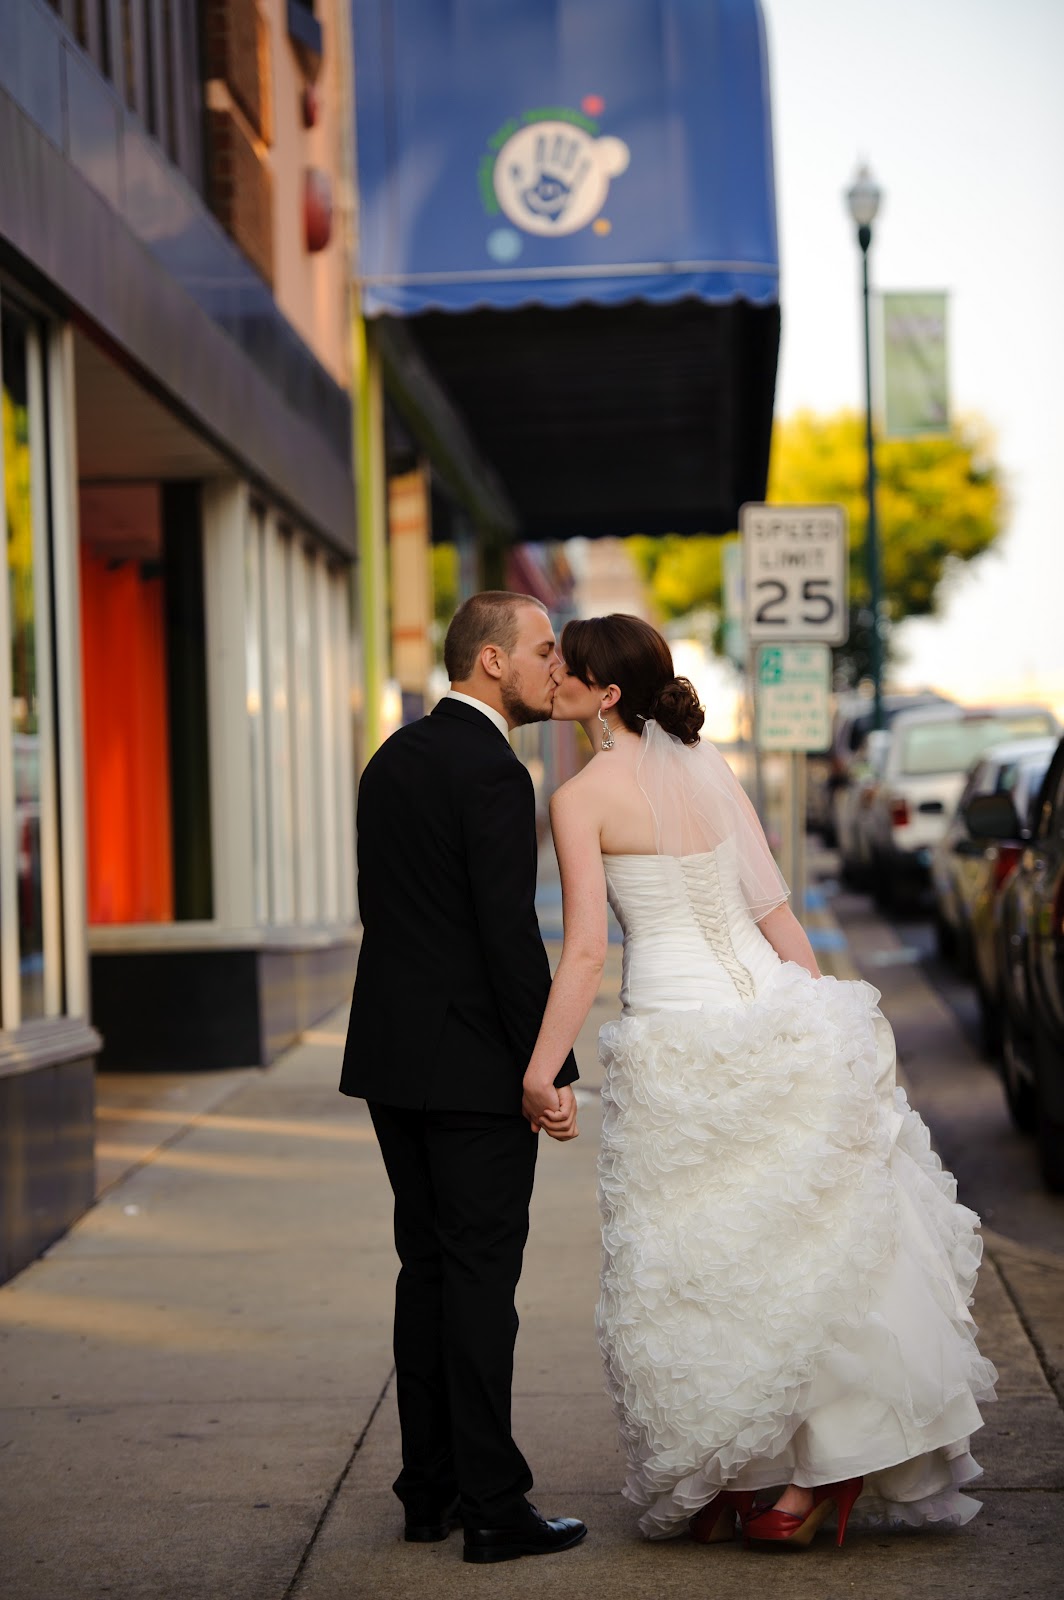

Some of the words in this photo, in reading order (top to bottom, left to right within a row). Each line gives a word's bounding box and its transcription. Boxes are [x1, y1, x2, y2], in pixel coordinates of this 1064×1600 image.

[754, 519, 836, 539] SPEED
[759, 547, 824, 569] LIMIT
[756, 579, 834, 624] 25
